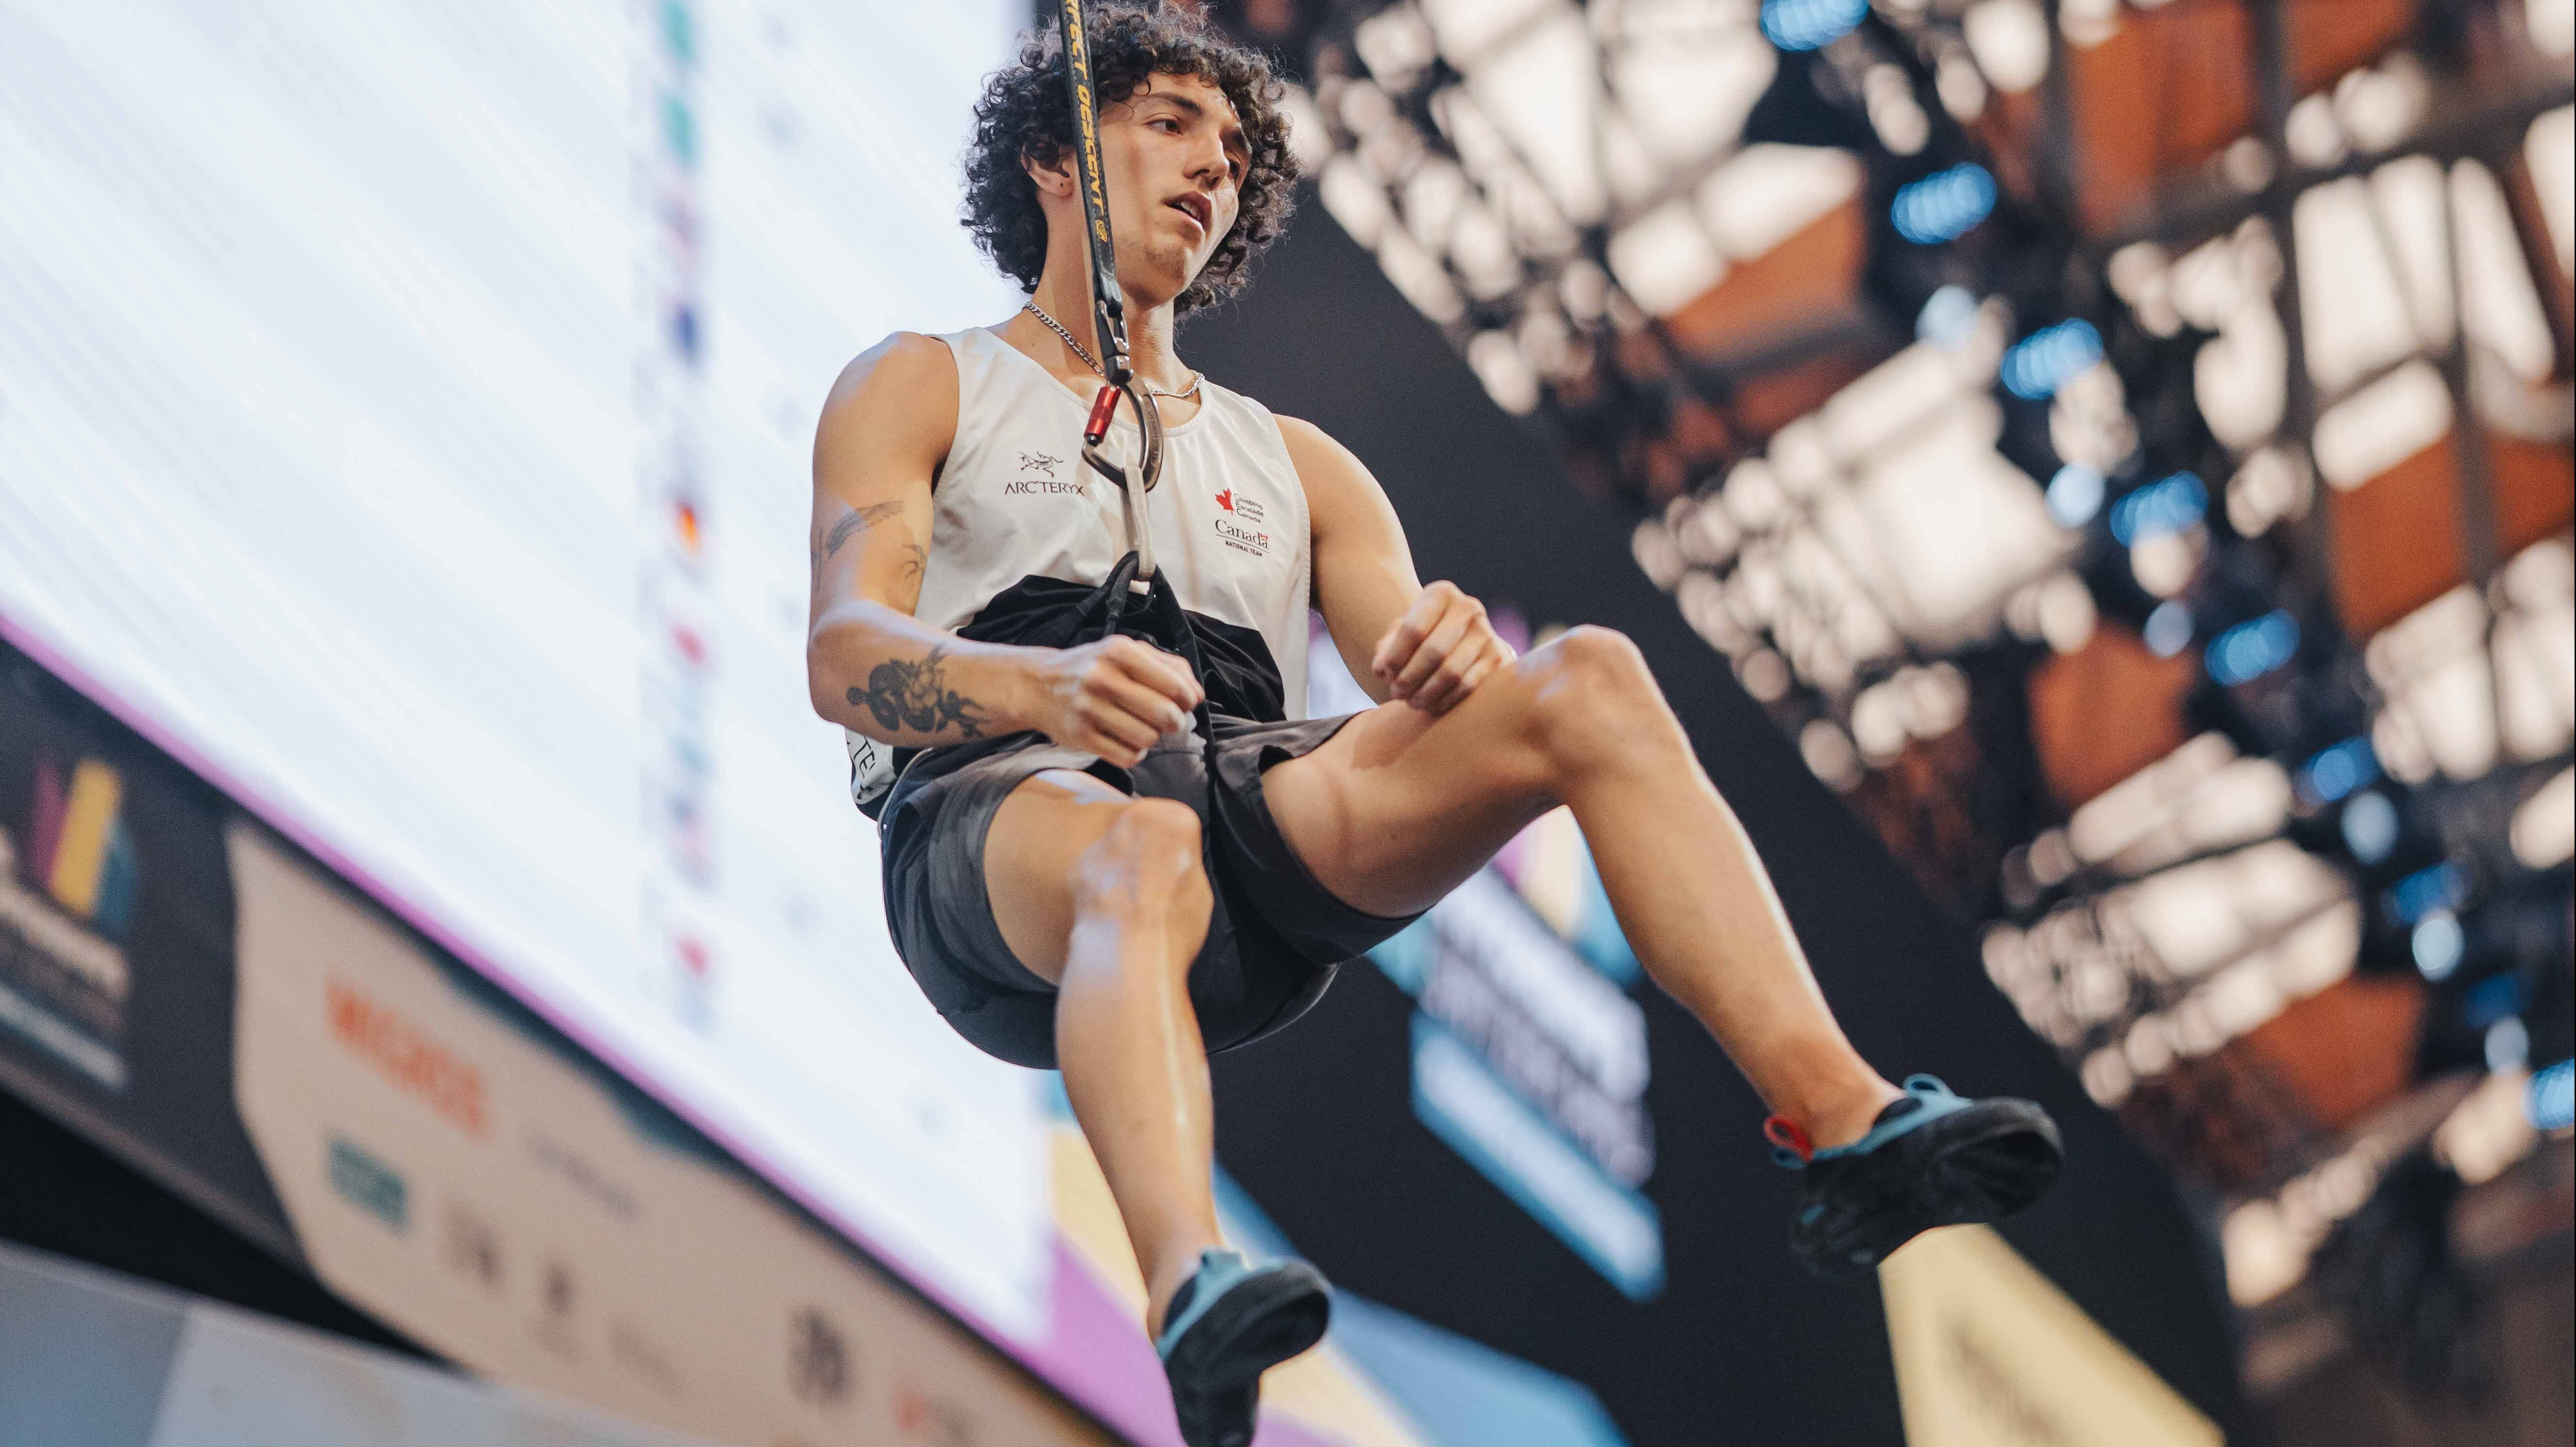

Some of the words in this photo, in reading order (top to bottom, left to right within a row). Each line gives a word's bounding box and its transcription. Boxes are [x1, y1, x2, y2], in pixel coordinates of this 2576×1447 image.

[1077, 84, 1104, 217] DESCENT
[1005, 481, 1084, 495] ARC'TERYX
[1234, 493, 1263, 510] Climbing
[1235, 500, 1264, 517] Escalade
[1237, 508, 1261, 524] Canada
[1215, 519, 1269, 549] Canada
[1225, 541, 1249, 553] NATIONAL
[1250, 549, 1263, 558] TEAM
